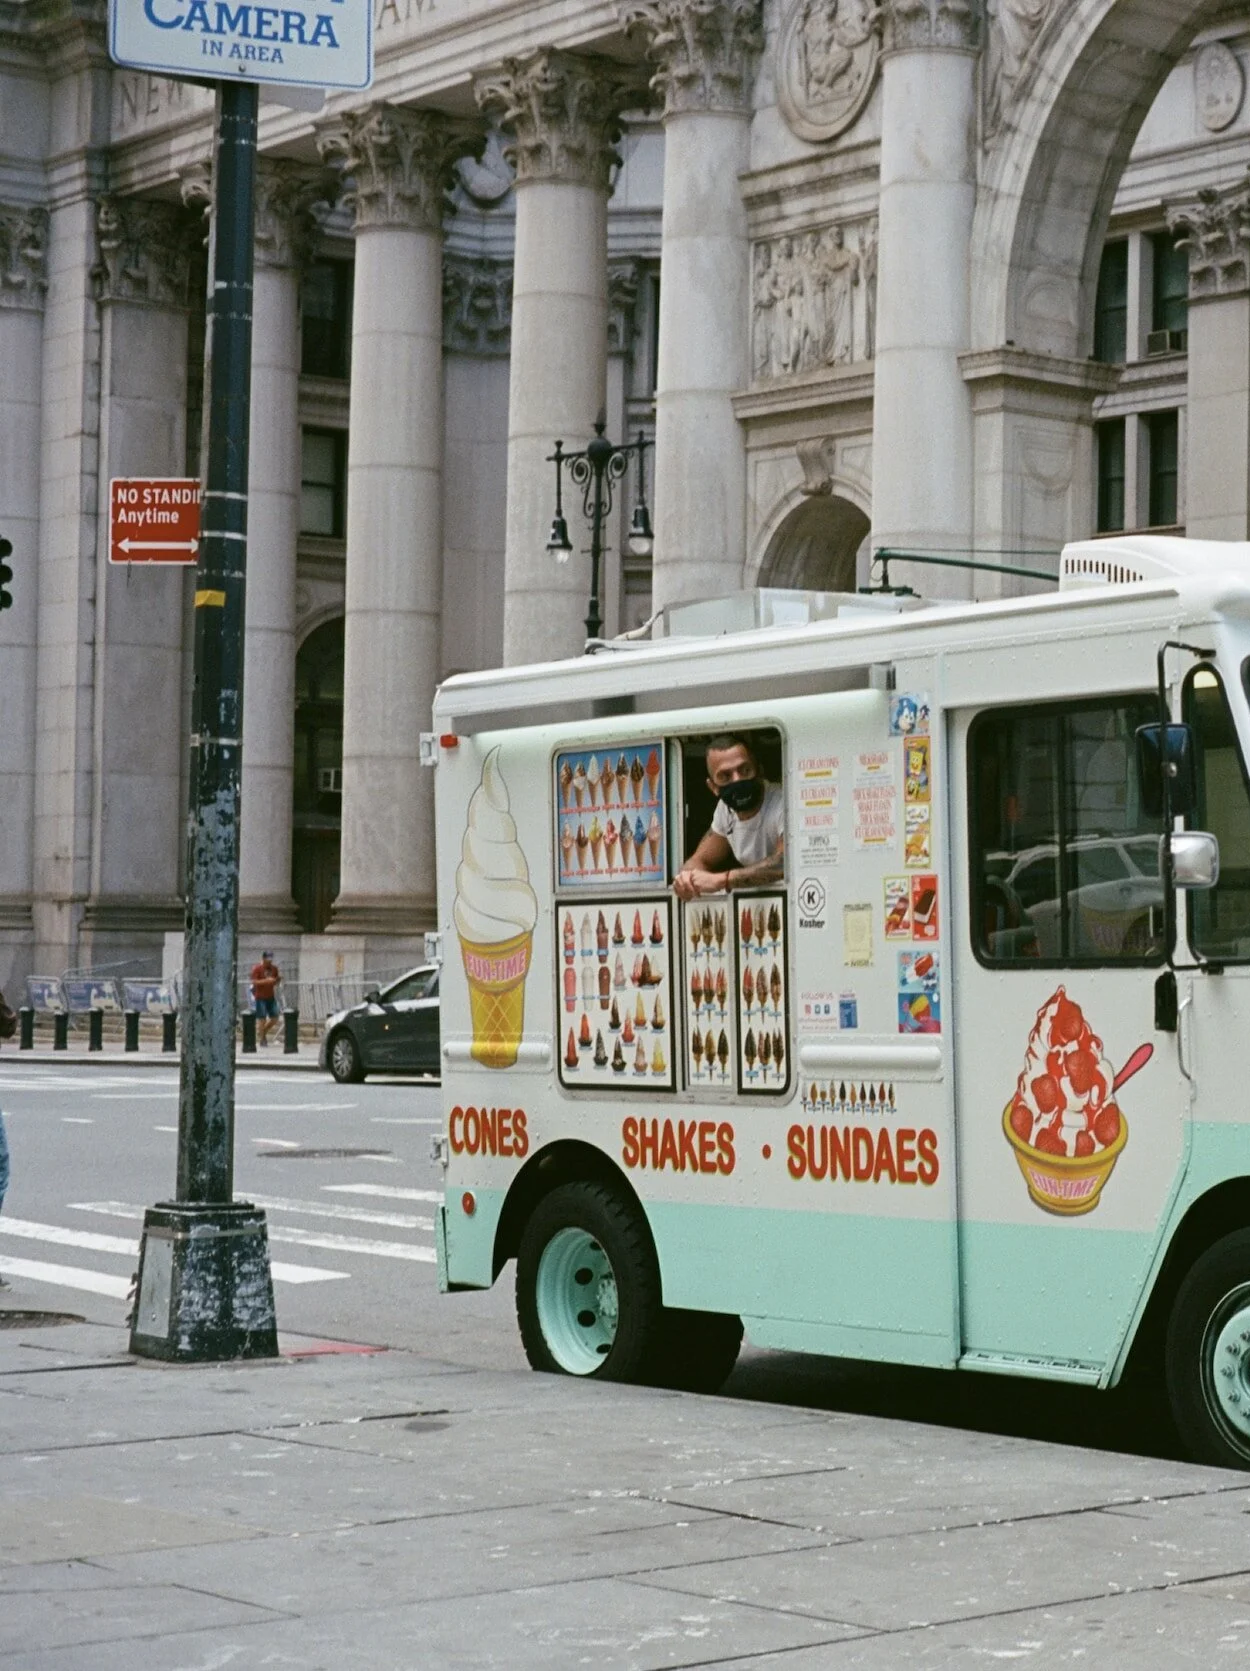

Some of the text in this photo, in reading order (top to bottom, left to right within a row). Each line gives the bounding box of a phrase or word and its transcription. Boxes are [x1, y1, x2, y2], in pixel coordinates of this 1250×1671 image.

[143, 0, 340, 48] CAMERA
[202, 39, 284, 64] IN AREA
[117, 488, 138, 504] NO
[117, 508, 179, 527] Anytime
[799, 918, 825, 929] Kosher
[466, 949, 526, 981] FUN-TIME
[450, 1106, 529, 1158] CONES
[622, 1116, 940, 1186] SHAKES SUNDAES
[1028, 1168, 1100, 1200] FUN-TIME
